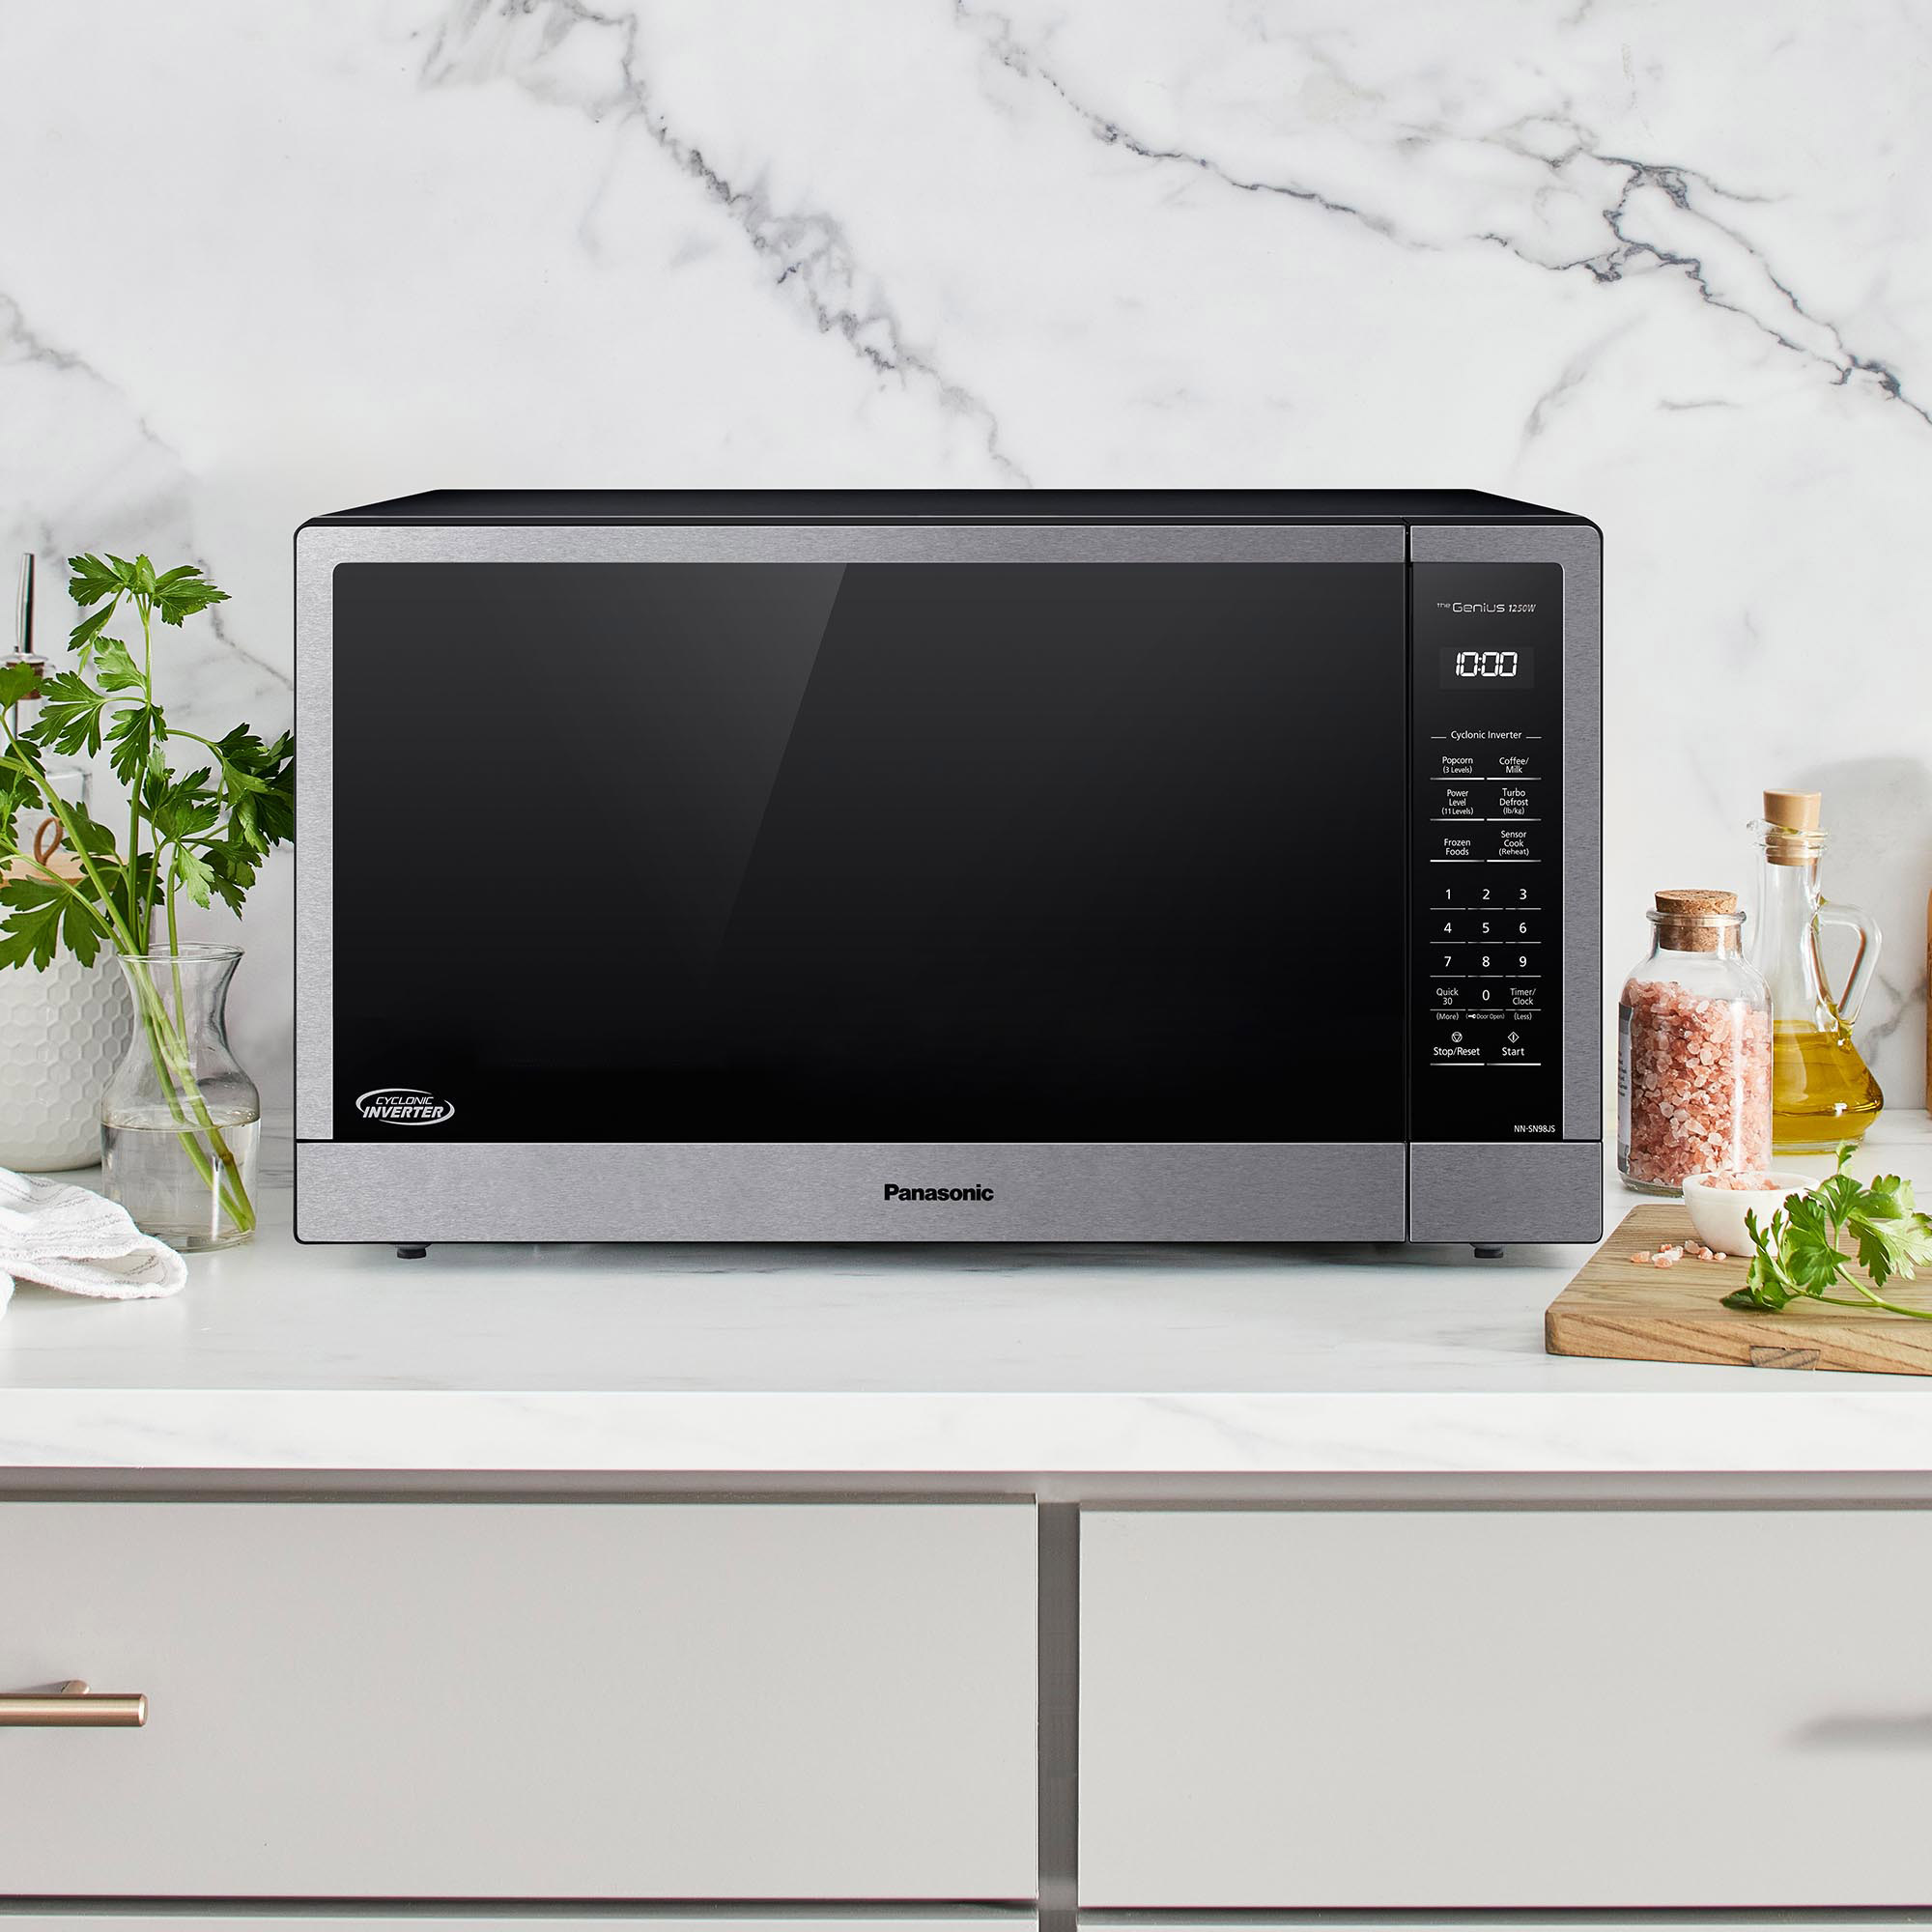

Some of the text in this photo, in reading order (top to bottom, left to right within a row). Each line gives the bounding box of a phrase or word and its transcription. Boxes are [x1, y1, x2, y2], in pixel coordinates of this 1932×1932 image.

[1452, 602, 1505, 612] Genius
[1509, 604, 1536, 612] 1250W
[1455, 652, 1518, 677] 10:00
[1450, 730, 1486, 741] Cyclonic
[1442, 756, 1474, 765] Popcorn
[1499, 757, 1530, 765] Coffee/
[1443, 766, 1449, 774] (3
[1502, 788, 1526, 796] Turbo
[1499, 798, 1529, 806] Defrost
[1442, 807, 1451, 815] (11
[1503, 807, 1525, 815] (lb/kg)
[1501, 830, 1527, 838] Sensor
[1444, 838, 1471, 847] Frozen
[1504, 839, 1524, 847] Cook
[1446, 848, 1469, 856] Foods
[1499, 848, 1530, 856] (Reheat)
[1446, 889, 1450, 900] 1
[1482, 889, 1490, 900] 2
[1519, 889, 1527, 900] 3
[1444, 923, 1452, 934] 4
[1482, 923, 1490, 934] 5
[1519, 923, 1527, 934] 6
[1444, 956, 1451, 967] 7
[1482, 956, 1490, 967] 8
[1519, 956, 1527, 967] 9
[1436, 988, 1459, 996] Quick
[1482, 990, 1490, 1001] 0
[1510, 988, 1536, 996] Timer/
[1443, 997, 1453, 1005] 30
[1512, 997, 1534, 1005] Clock
[1433, 1047, 1480, 1057] Stop/Reset
[1502, 1047, 1525, 1056] Start
[375, 1097, 434, 1105] CYCLONIC
[363, 1106, 444, 1118] INVERTER
[884, 1184, 994, 1201] Panasonic
